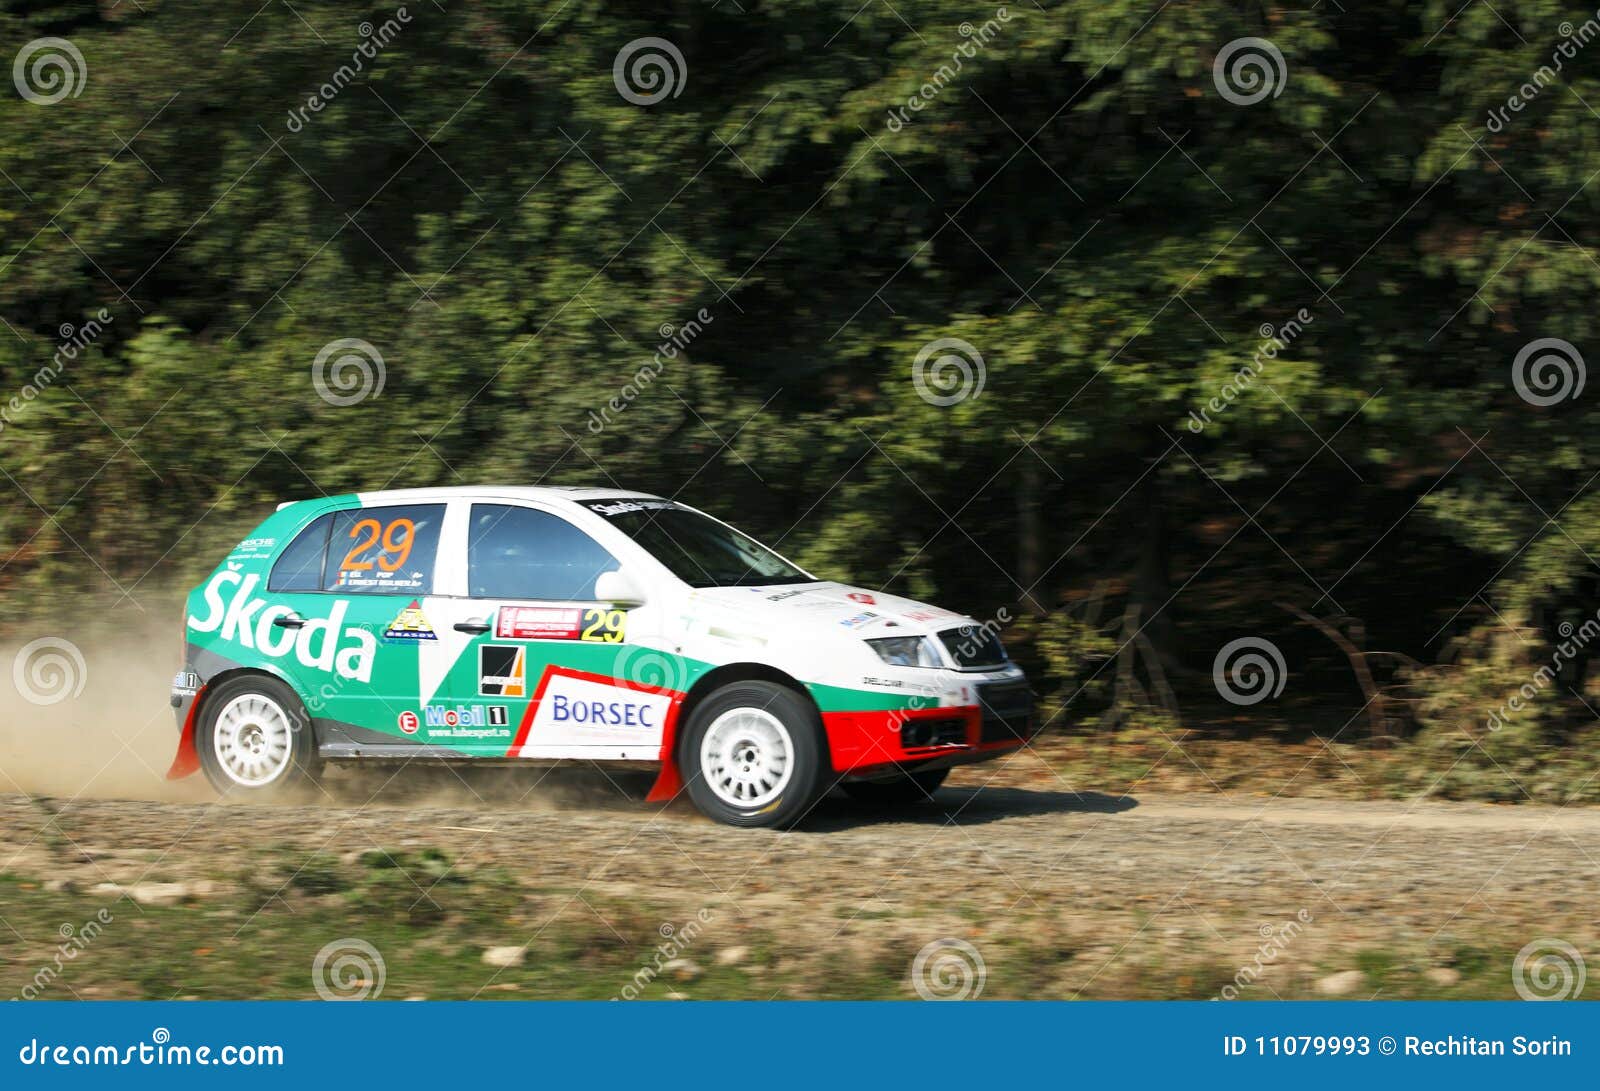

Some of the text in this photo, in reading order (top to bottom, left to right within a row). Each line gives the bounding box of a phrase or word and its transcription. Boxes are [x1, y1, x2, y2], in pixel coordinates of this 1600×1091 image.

[341, 518, 415, 572] 29
[187, 561, 376, 684] Škoda
[581, 609, 627, 643] 29
[425, 705, 485, 726] Mobil
[553, 695, 653, 728] BORSEC
